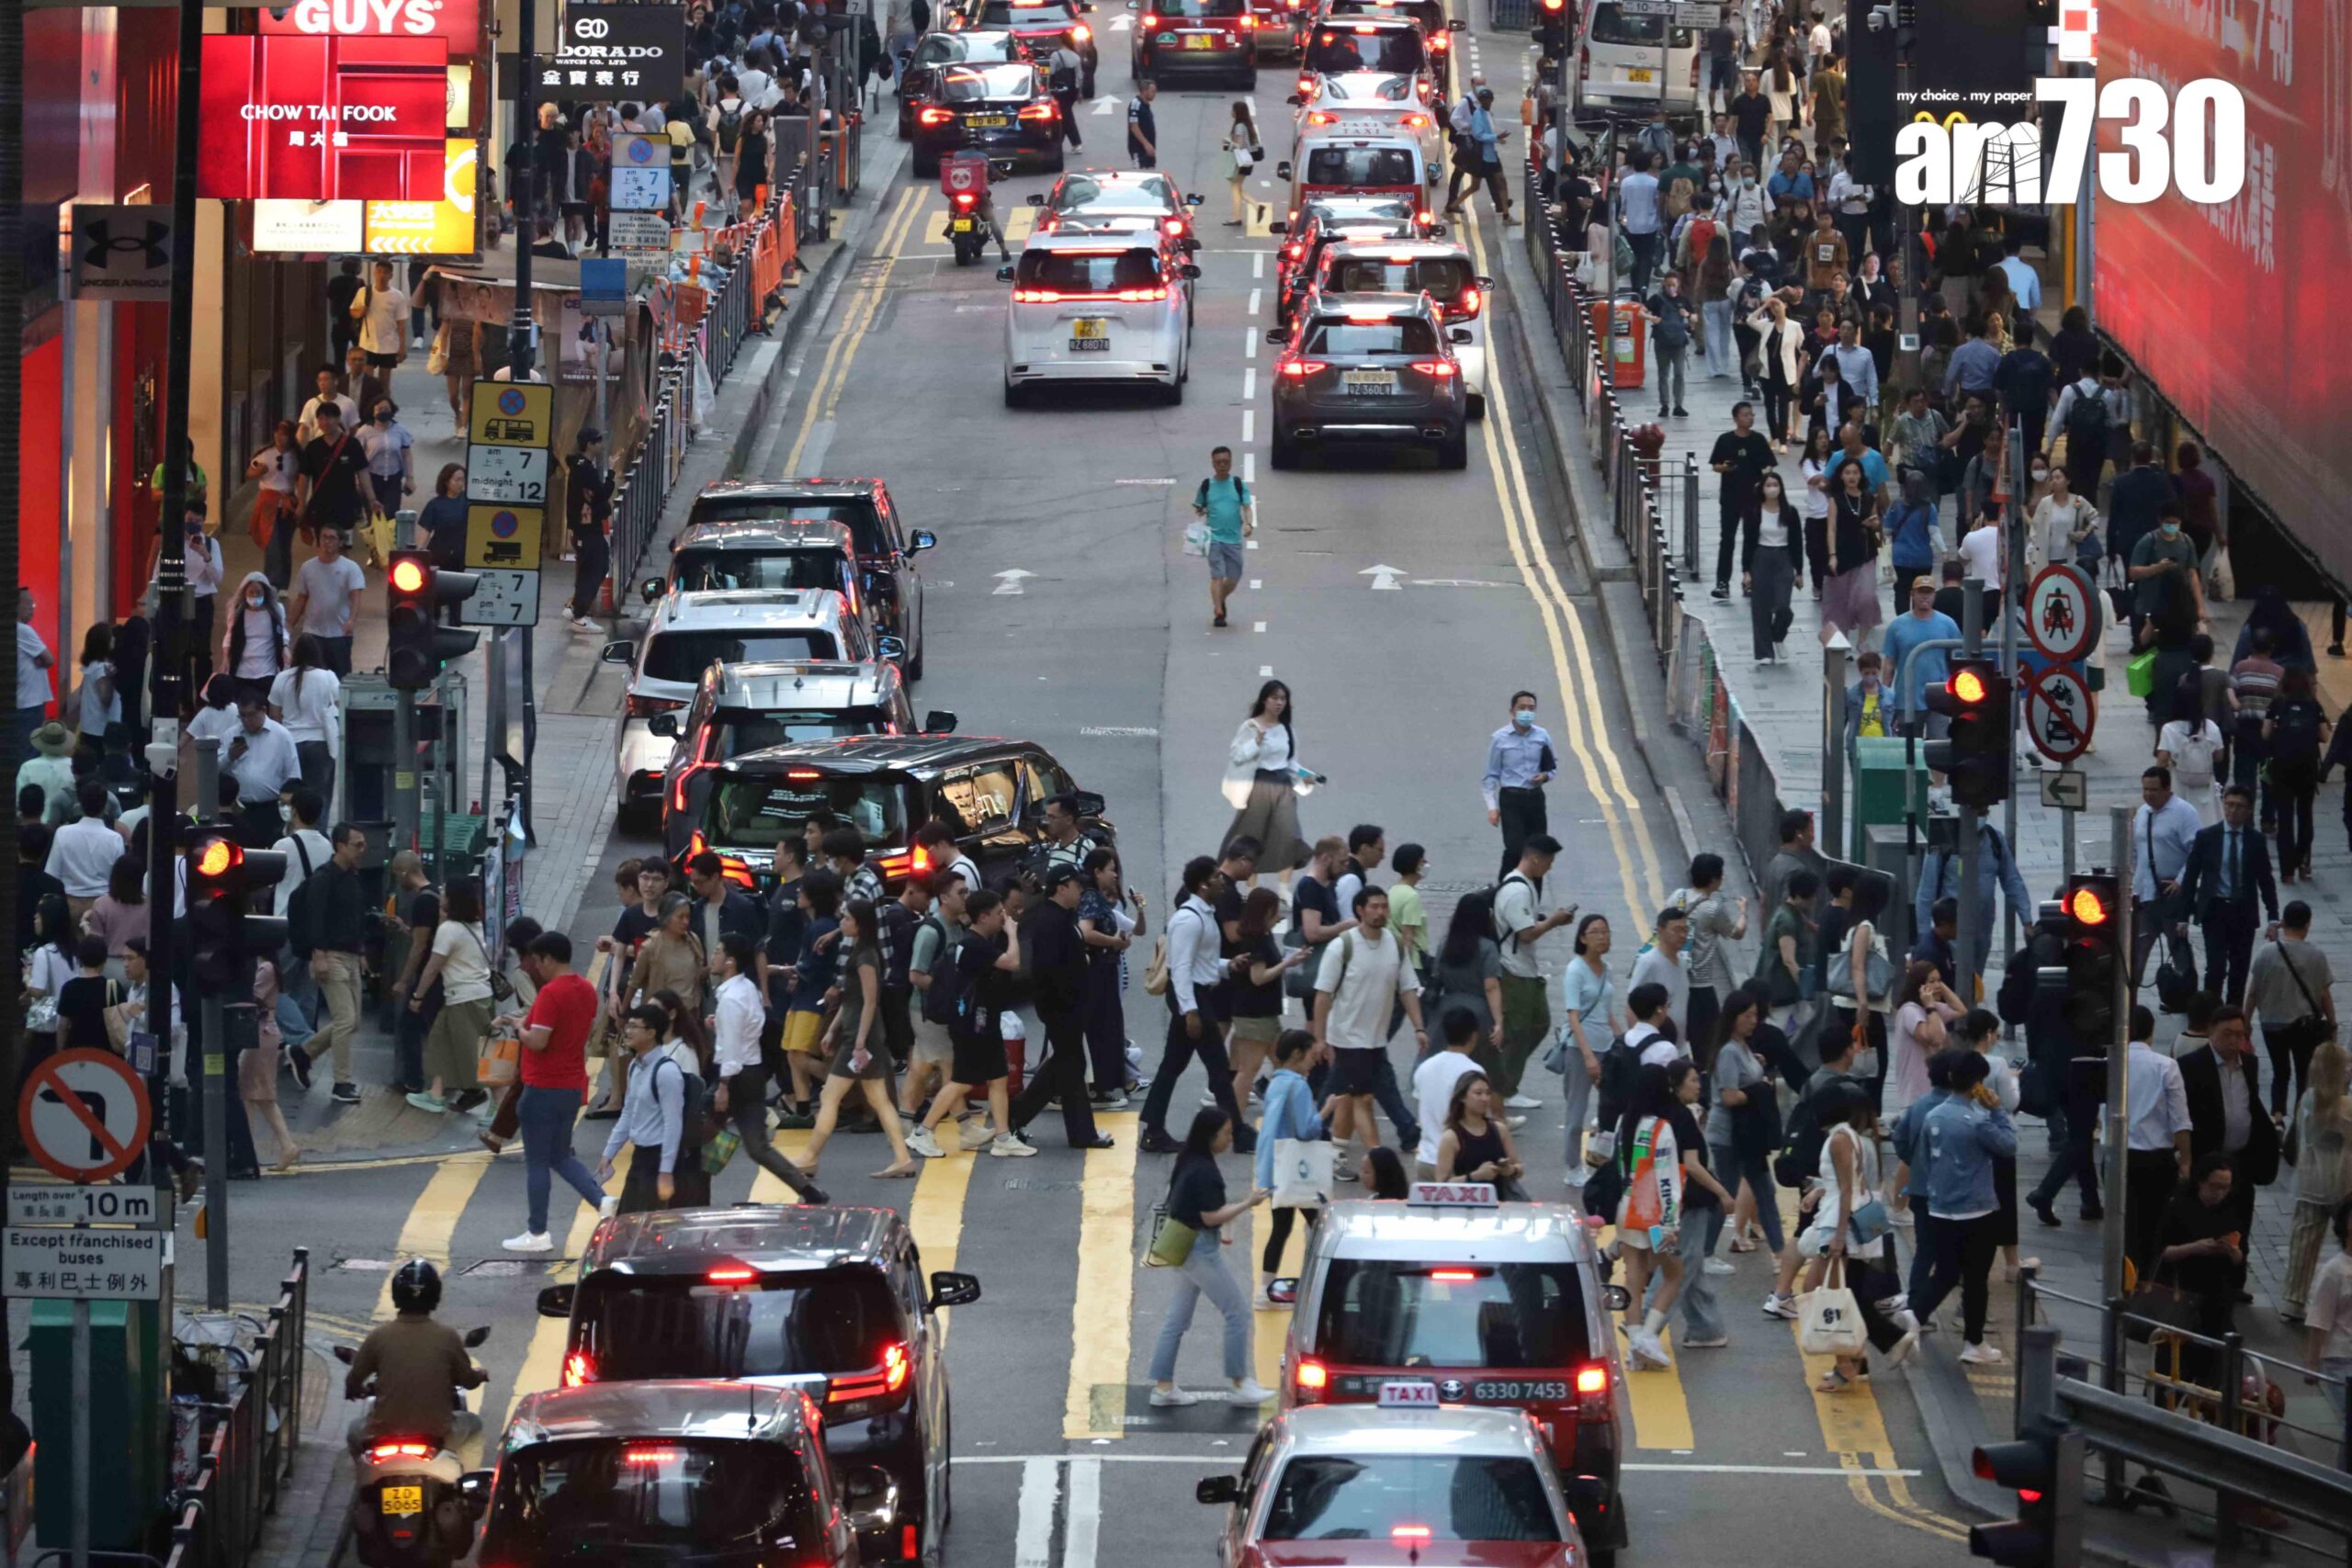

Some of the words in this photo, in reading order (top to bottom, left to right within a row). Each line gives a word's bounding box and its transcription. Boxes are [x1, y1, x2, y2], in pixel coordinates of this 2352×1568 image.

[294, 0, 436, 34] GUYS
[542, 70, 639, 85] 金寶表行
[240, 104, 303, 120] CHOW
[306, 105, 336, 120] TAI
[343, 105, 397, 121] FOOK
[288, 130, 348, 147] 周大福
[649, 171, 660, 185] 7
[649, 193, 659, 207] 7
[79, 278, 119, 288] UNDER
[519, 451, 533, 469] 7
[471, 477, 514, 487] midnight
[518, 481, 542, 500] 12
[512, 573, 524, 592] 7
[480, 601, 493, 609] pm
[510, 604, 523, 621] 7
[12, 1190, 50, 1201] Length
[52, 1191, 76, 1200] over
[1418, 1186, 1489, 1202] TAXI
[85, 1191, 119, 1217] 10
[125, 1197, 149, 1216] m
[10, 1233, 64, 1249] Except
[69, 1233, 153, 1250] franchised
[58, 1250, 105, 1266] buses
[14, 1270, 149, 1293] 專利巴士例外
[1386, 1386, 1435, 1403] TAXI
[1475, 1382, 1521, 1399] 6330
[1524, 1382, 1566, 1399] 7453
[384, 1499, 420, 1511] 5065
